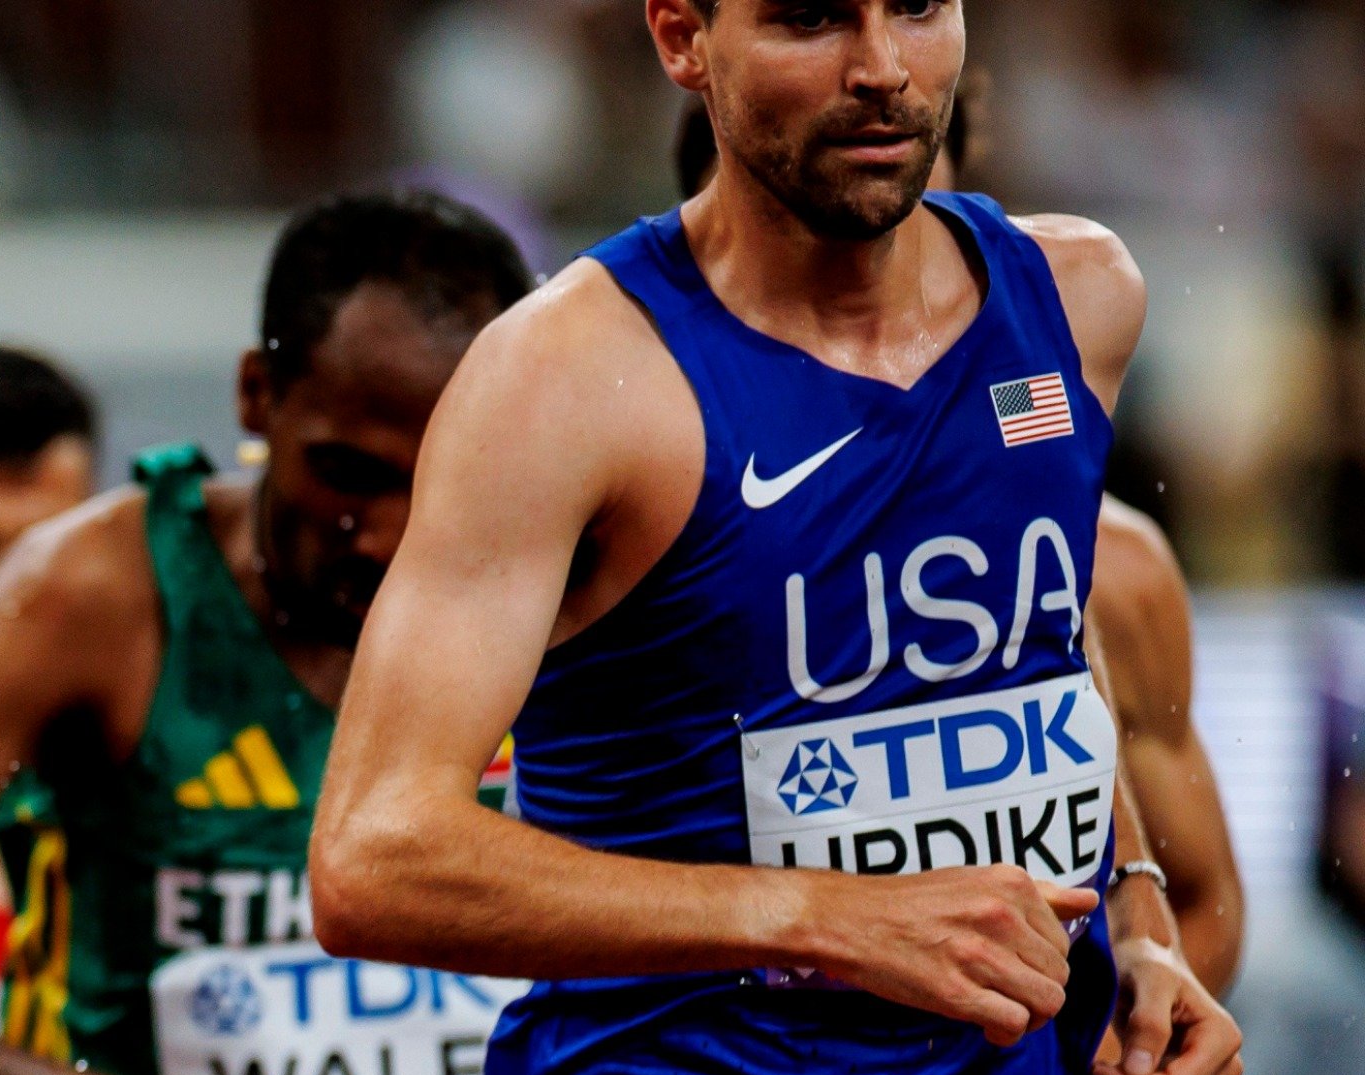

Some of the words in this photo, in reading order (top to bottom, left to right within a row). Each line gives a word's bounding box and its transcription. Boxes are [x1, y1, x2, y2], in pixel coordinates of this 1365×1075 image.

[786, 516, 1081, 703] USA
[853, 690, 1095, 800] TDK
[265, 957, 497, 1027] TDK
